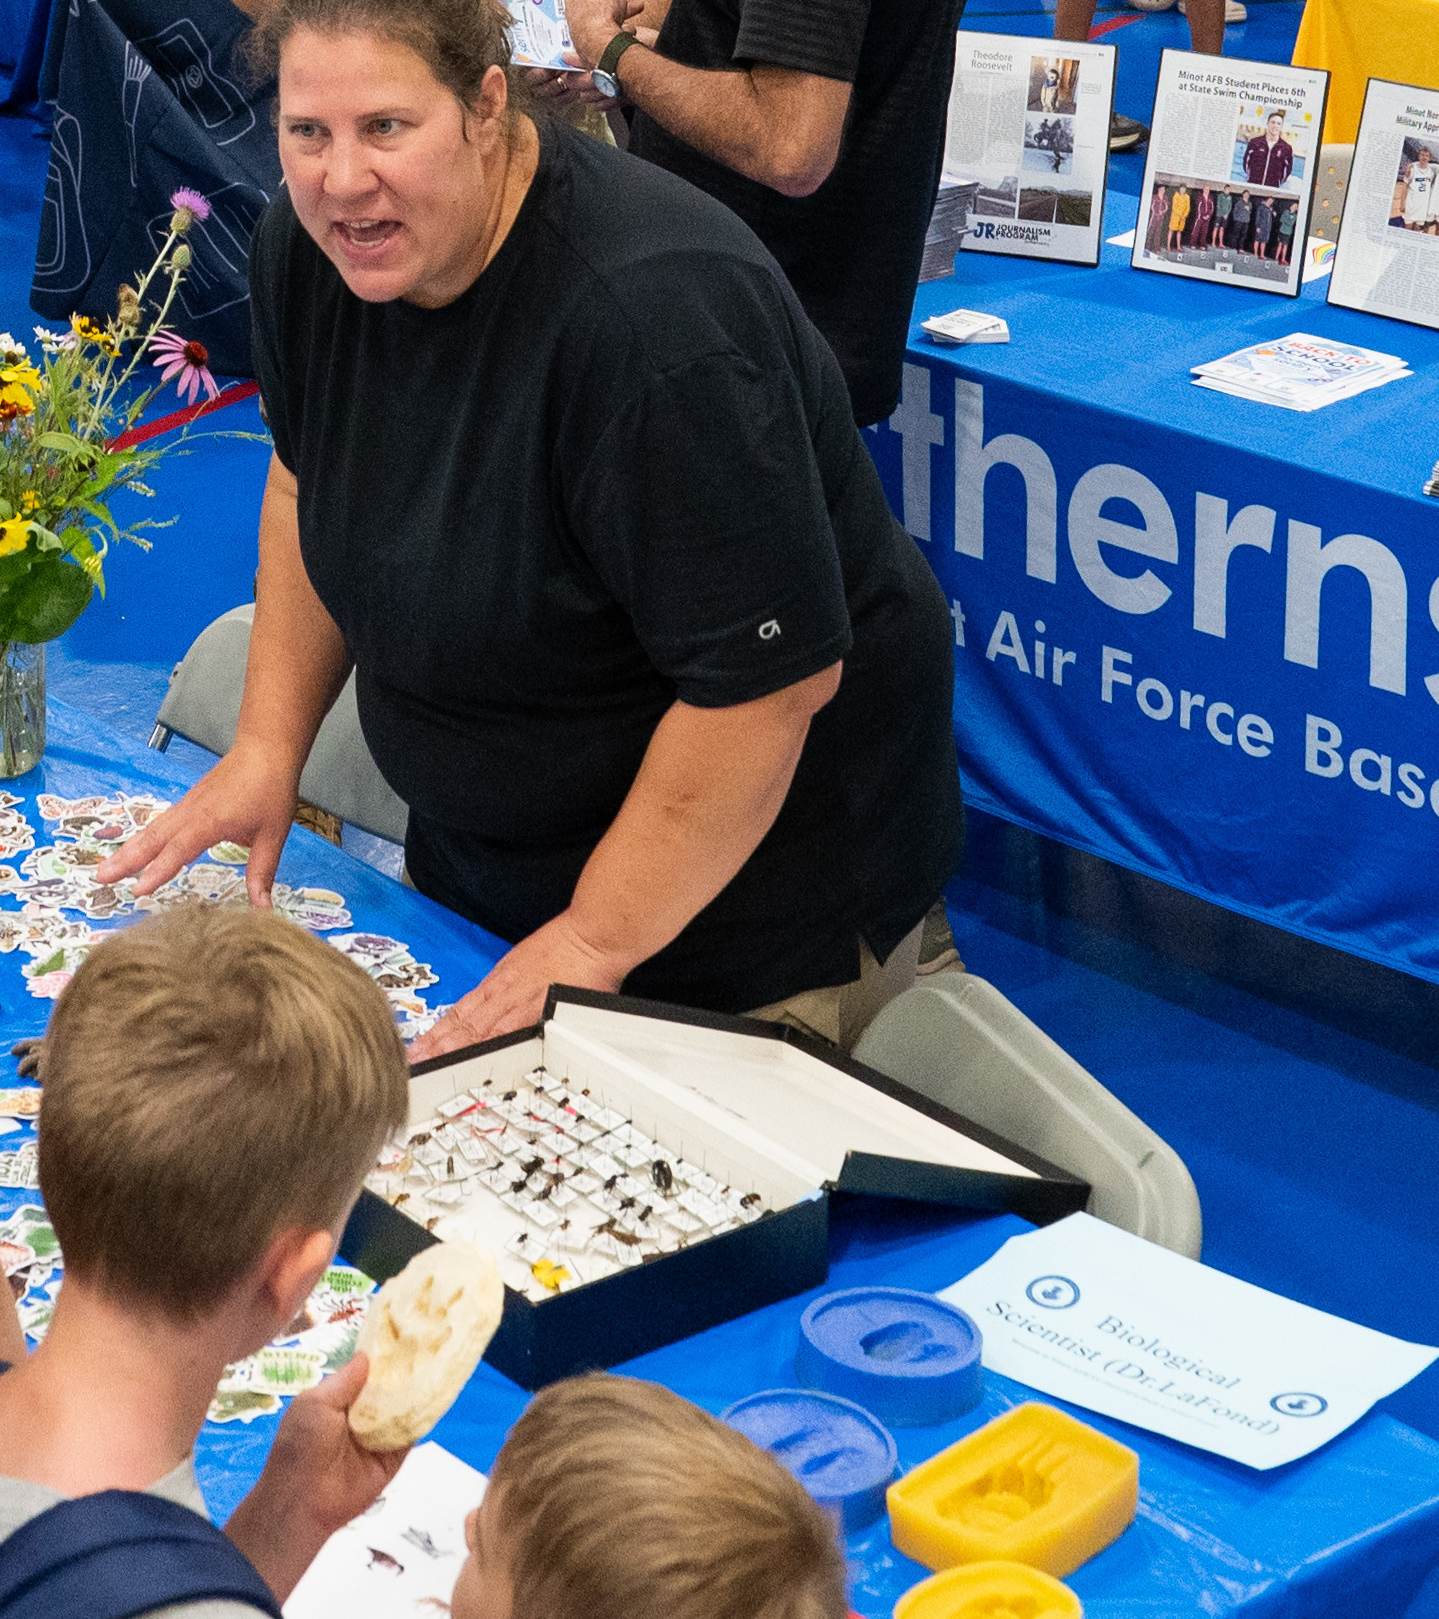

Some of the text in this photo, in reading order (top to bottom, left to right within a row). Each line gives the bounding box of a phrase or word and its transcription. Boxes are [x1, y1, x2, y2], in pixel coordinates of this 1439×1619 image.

[971, 60, 1013, 72] Roosevelt
[973, 50, 1013, 62] Theodore
[1178, 70, 1306, 97] Minot AFB Student Places 6th
[1178, 82, 1303, 109] at State Swim Championship
[1405, 105, 1425, 117] Minot
[1396, 115, 1423, 130] Military
[974, 221, 995, 240] JR
[996, 224, 1051, 237] JOURNALISM
[996, 230, 1039, 241] PROGRAM
[1272, 346, 1358, 371] SCHOOL
[1287, 342, 1371, 366] BACK TO
[985, 610, 1076, 687] Air
[1100, 643, 1275, 760] Force
[986, 1300, 1104, 1364] Scientist
[1094, 1314, 1242, 1391] Biological
